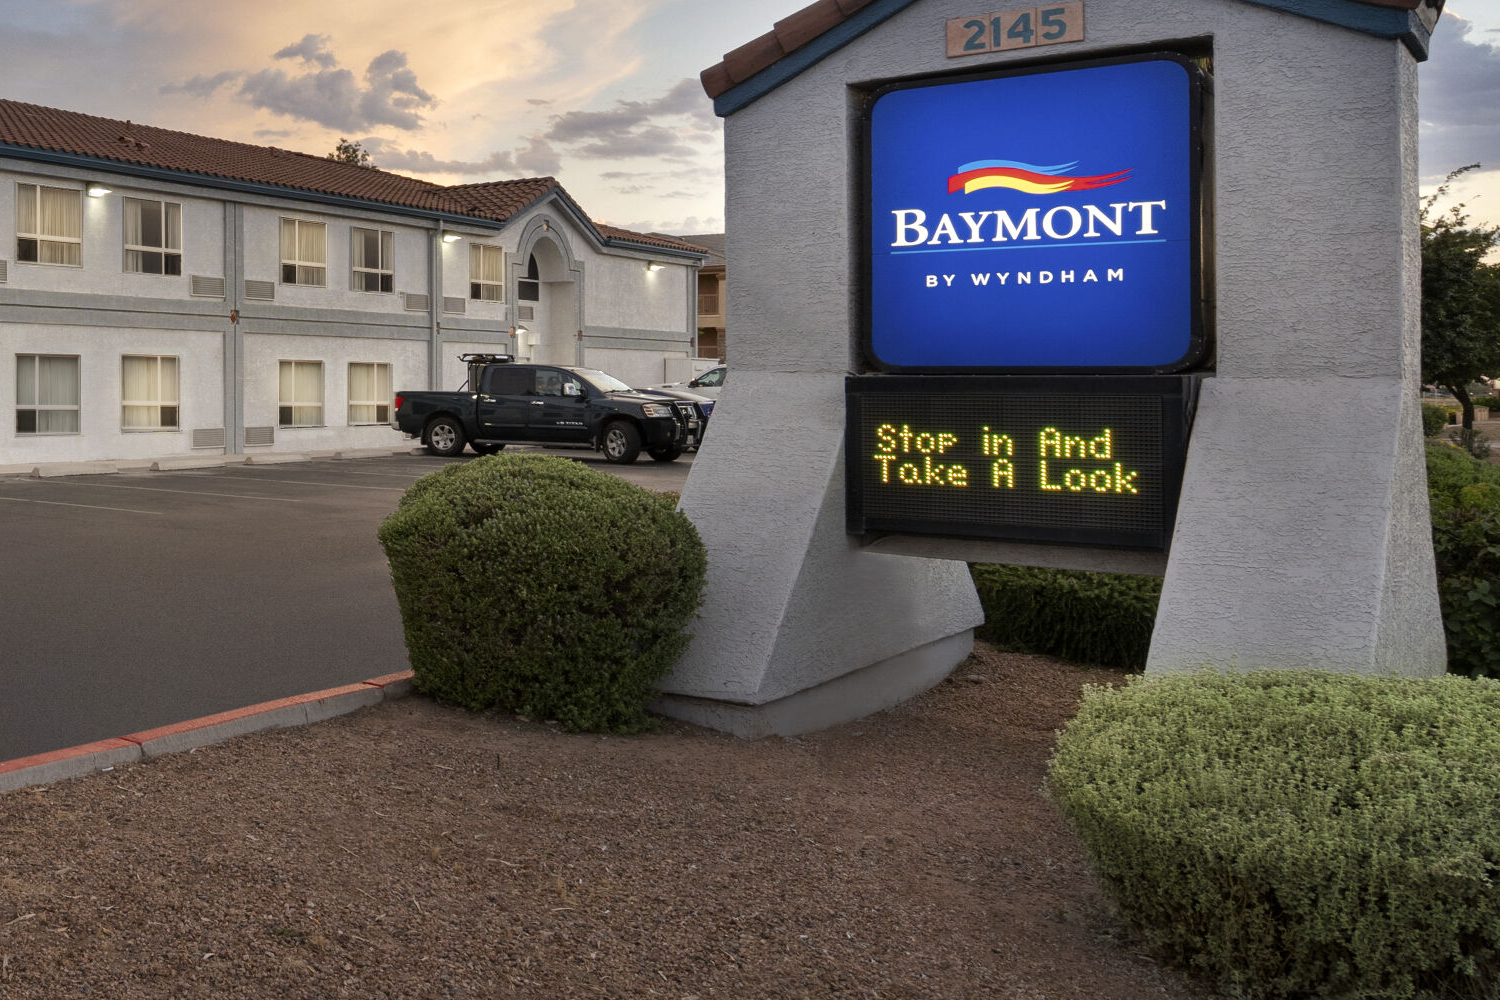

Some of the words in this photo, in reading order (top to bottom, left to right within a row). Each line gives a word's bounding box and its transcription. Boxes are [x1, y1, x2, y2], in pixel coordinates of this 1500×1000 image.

[963, 8, 1067, 52] 2145
[891, 199, 1167, 247] BAYMONT
[926, 274, 956, 288] BY
[971, 268, 1125, 287] WYNDHAM
[877, 424, 958, 454] Stop
[982, 426, 1013, 456] in
[1039, 427, 1111, 459] And
[874, 455, 967, 487] Take
[992, 459, 1014, 488] A
[1039, 460, 1138, 494] Look
